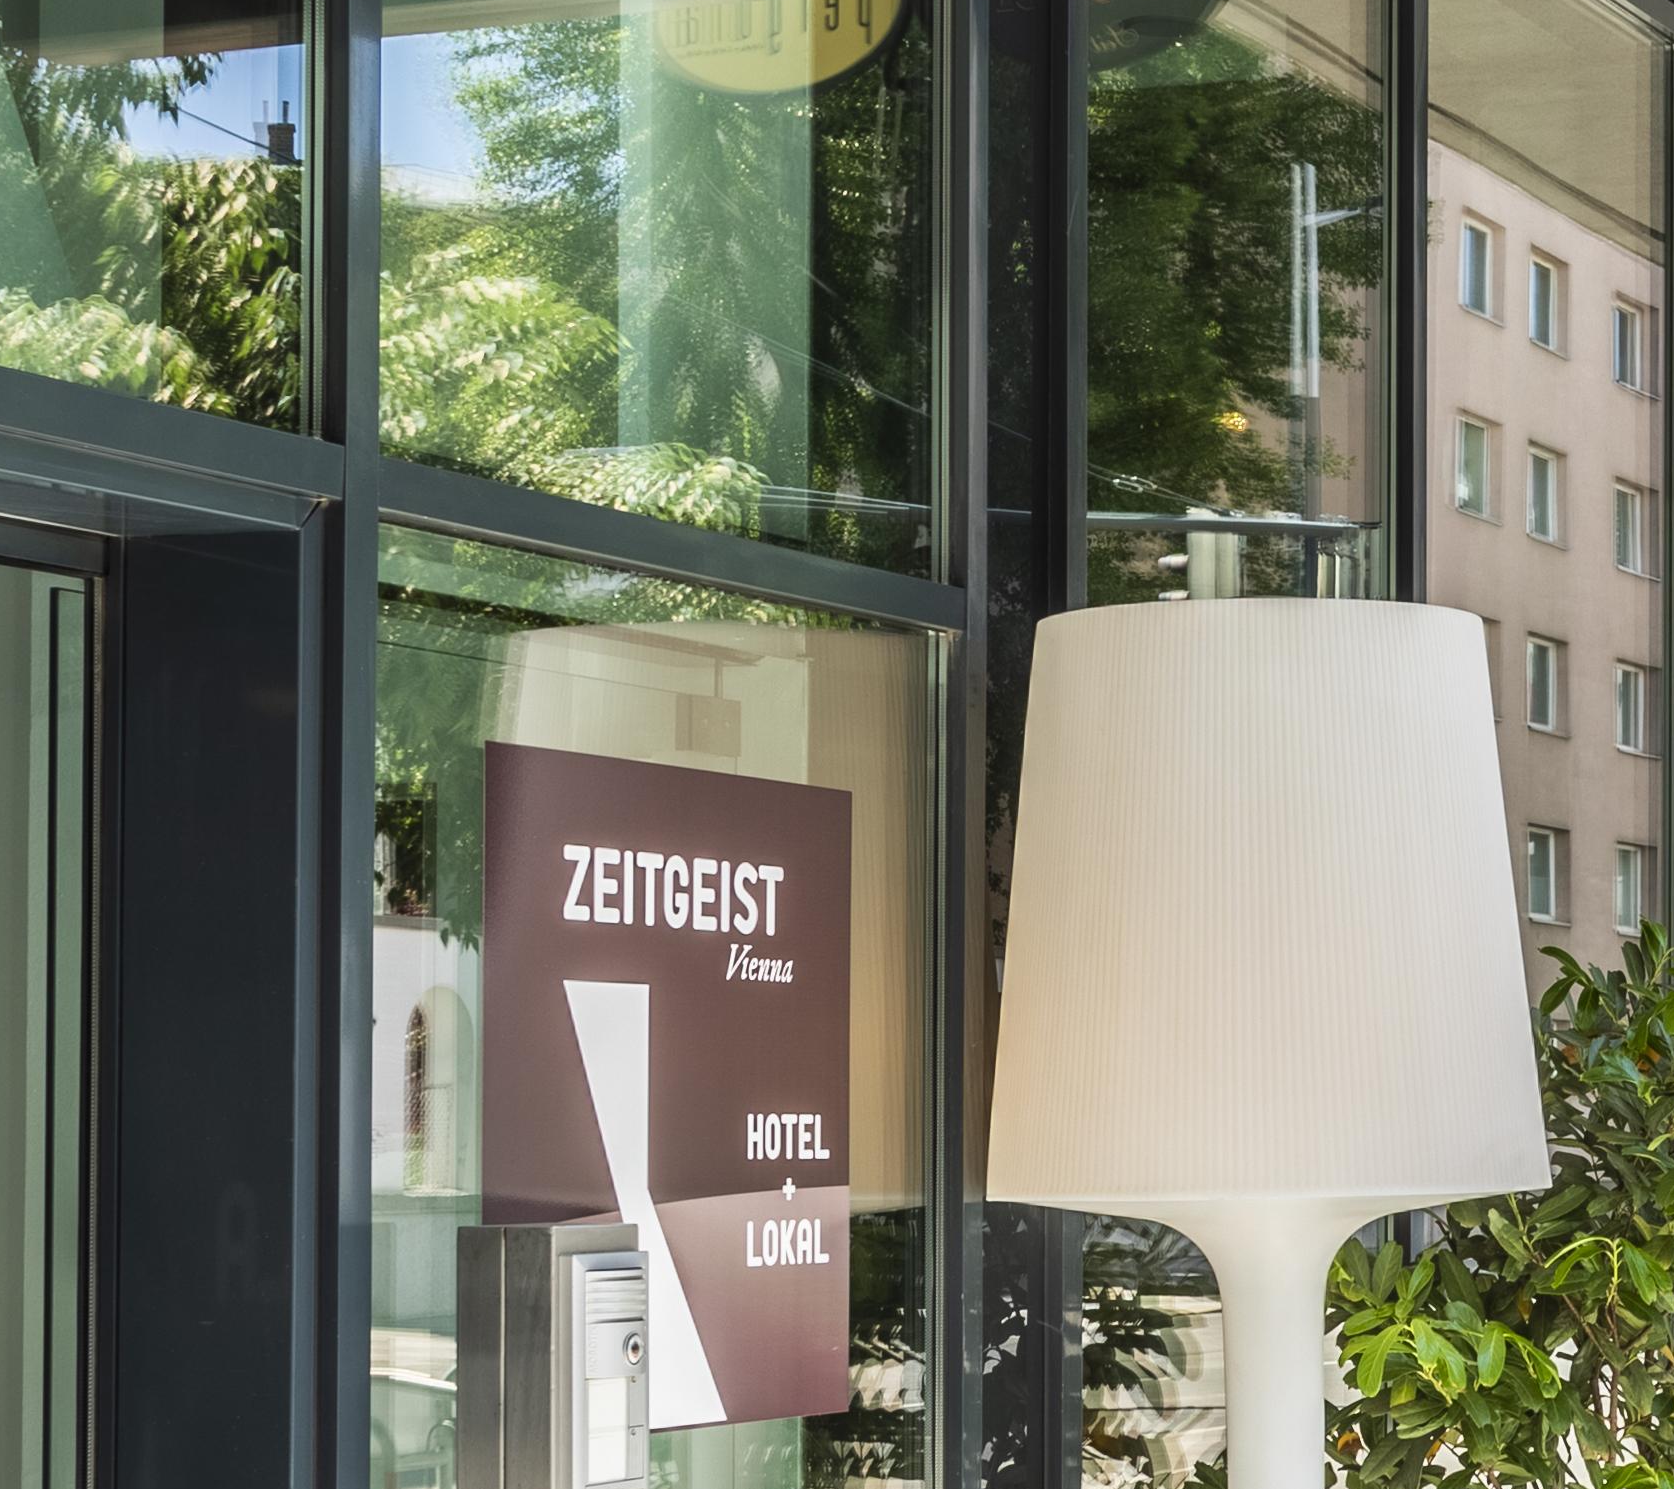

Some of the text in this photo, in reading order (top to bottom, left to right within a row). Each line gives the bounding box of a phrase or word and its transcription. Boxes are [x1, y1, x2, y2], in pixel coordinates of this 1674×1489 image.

[562, 843, 785, 937] ZEITGEIST
[725, 942, 795, 986] Vienna
[746, 1112, 831, 1162] HOTEL
[746, 1217, 830, 1268] LOKAL
